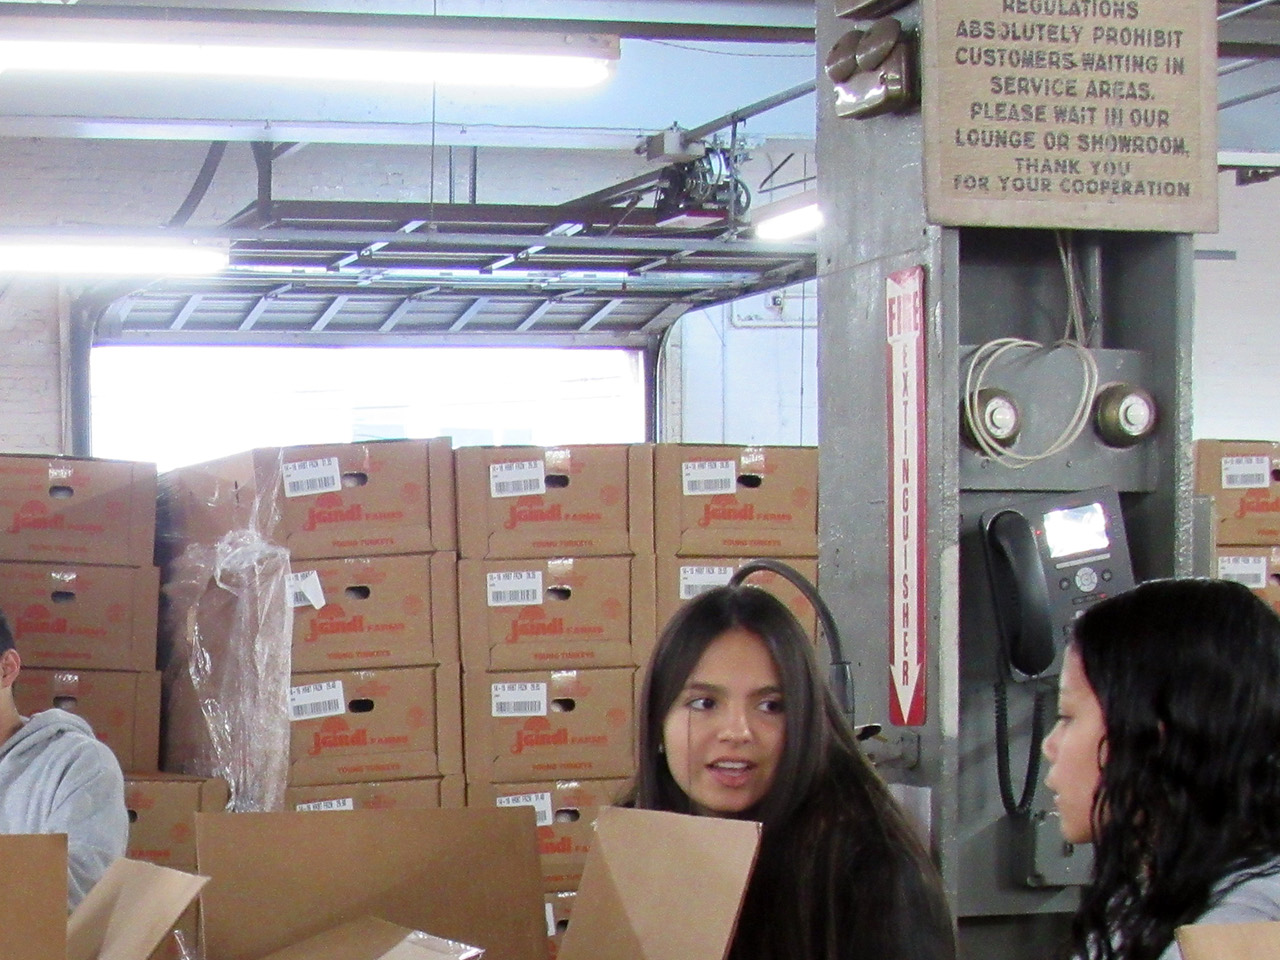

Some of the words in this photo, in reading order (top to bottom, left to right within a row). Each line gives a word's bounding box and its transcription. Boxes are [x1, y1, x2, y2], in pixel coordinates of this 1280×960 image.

[1003, 0, 1139, 19] REGULATIONS
[956, 20, 1083, 43] ABSOLUTELY
[1093, 26, 1183, 48] PROHIBIT
[955, 46, 1075, 69] CUSTOMERS
[1082, 52, 1158, 73] WAITING
[1166, 56, 1185, 75] IN
[991, 75, 1077, 96] SERVICE
[970, 102, 1047, 122] PLEASE
[1053, 105, 1097, 125] WAIT
[1104, 107, 1123, 127] IN
[1130, 108, 1169, 128] OUR
[955, 128, 1035, 149] LOUNGE
[1043, 131, 1070, 150] OR
[1014, 157, 1080, 174] THANK
[1090, 160, 1131, 176] YOU
[953, 174, 989, 193] FOR
[998, 175, 1052, 192] YOUR
[1059, 177, 1190, 197] COOPERATION
[887, 290, 919, 337] FIE
[901, 343, 910, 687] EXTINGUISHER
